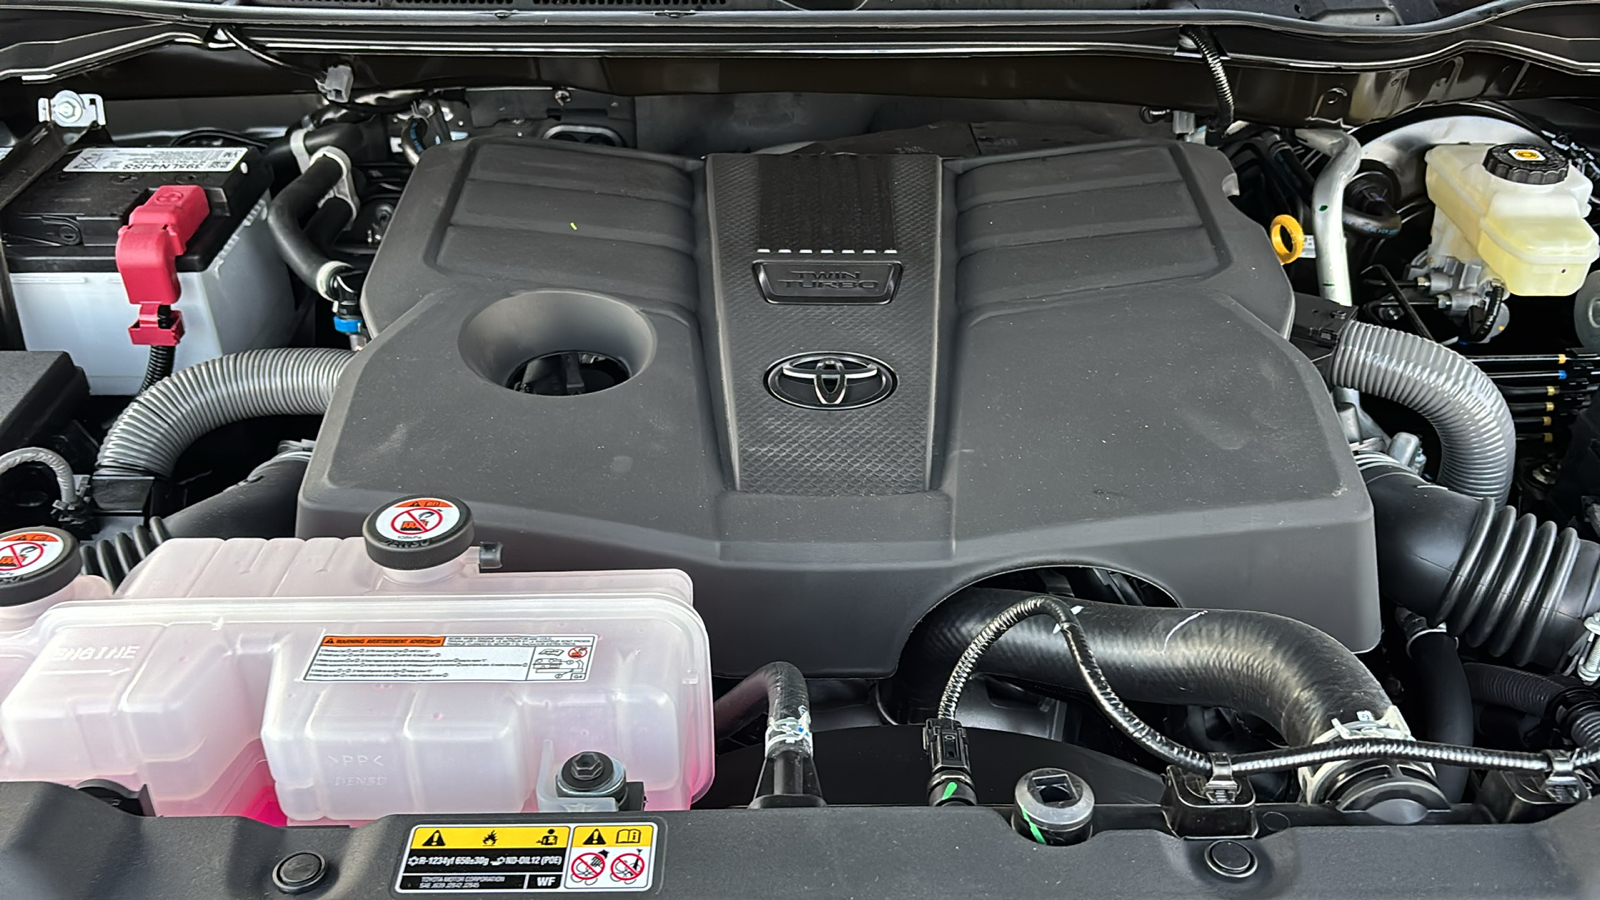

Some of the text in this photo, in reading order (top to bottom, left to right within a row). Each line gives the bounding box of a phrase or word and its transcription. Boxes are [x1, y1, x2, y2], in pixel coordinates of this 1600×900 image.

[790, 270, 860, 280] TWIN
[777, 279, 879, 289] TURBO
[53, 645, 140, 661] ENGINE
[540, 855, 562, 866] (POE)
[536, 876, 556, 887] WF
